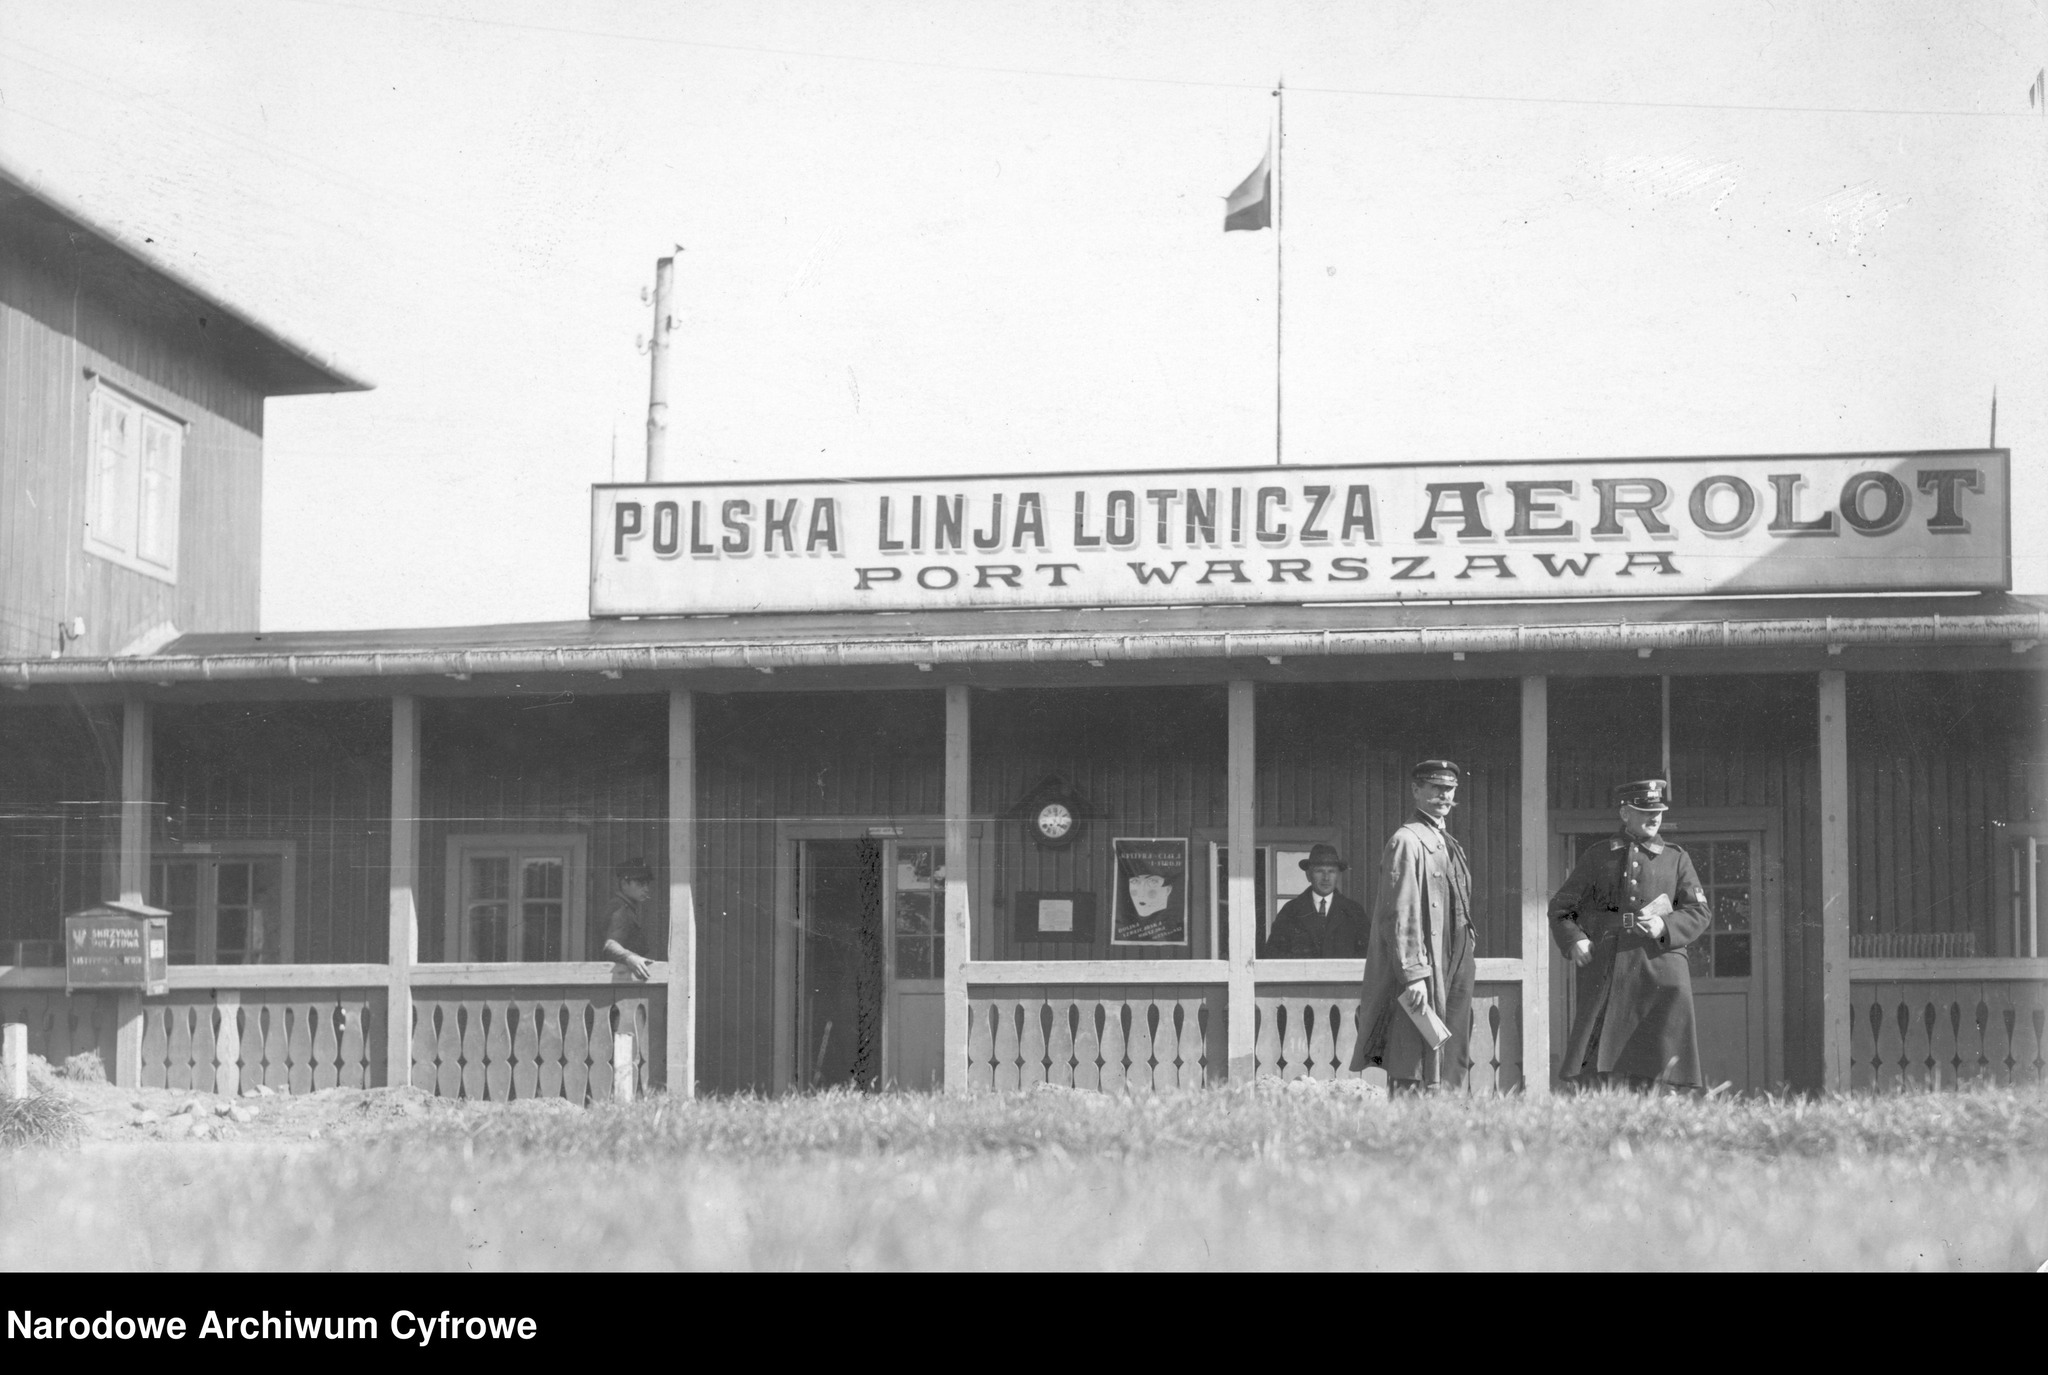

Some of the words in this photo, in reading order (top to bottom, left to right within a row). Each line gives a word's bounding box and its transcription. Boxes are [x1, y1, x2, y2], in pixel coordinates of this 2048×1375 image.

[614, 497, 839, 555] POLSKA
[878, 491, 1046, 550] LINJA
[1074, 484, 1376, 546] LOTNICZA
[1413, 469, 1979, 540] AEROLOT
[855, 563, 1081, 591] PORT
[1126, 551, 1682, 585] WARSZAWA
[92, 928, 139, 938] SKRZYNKA
